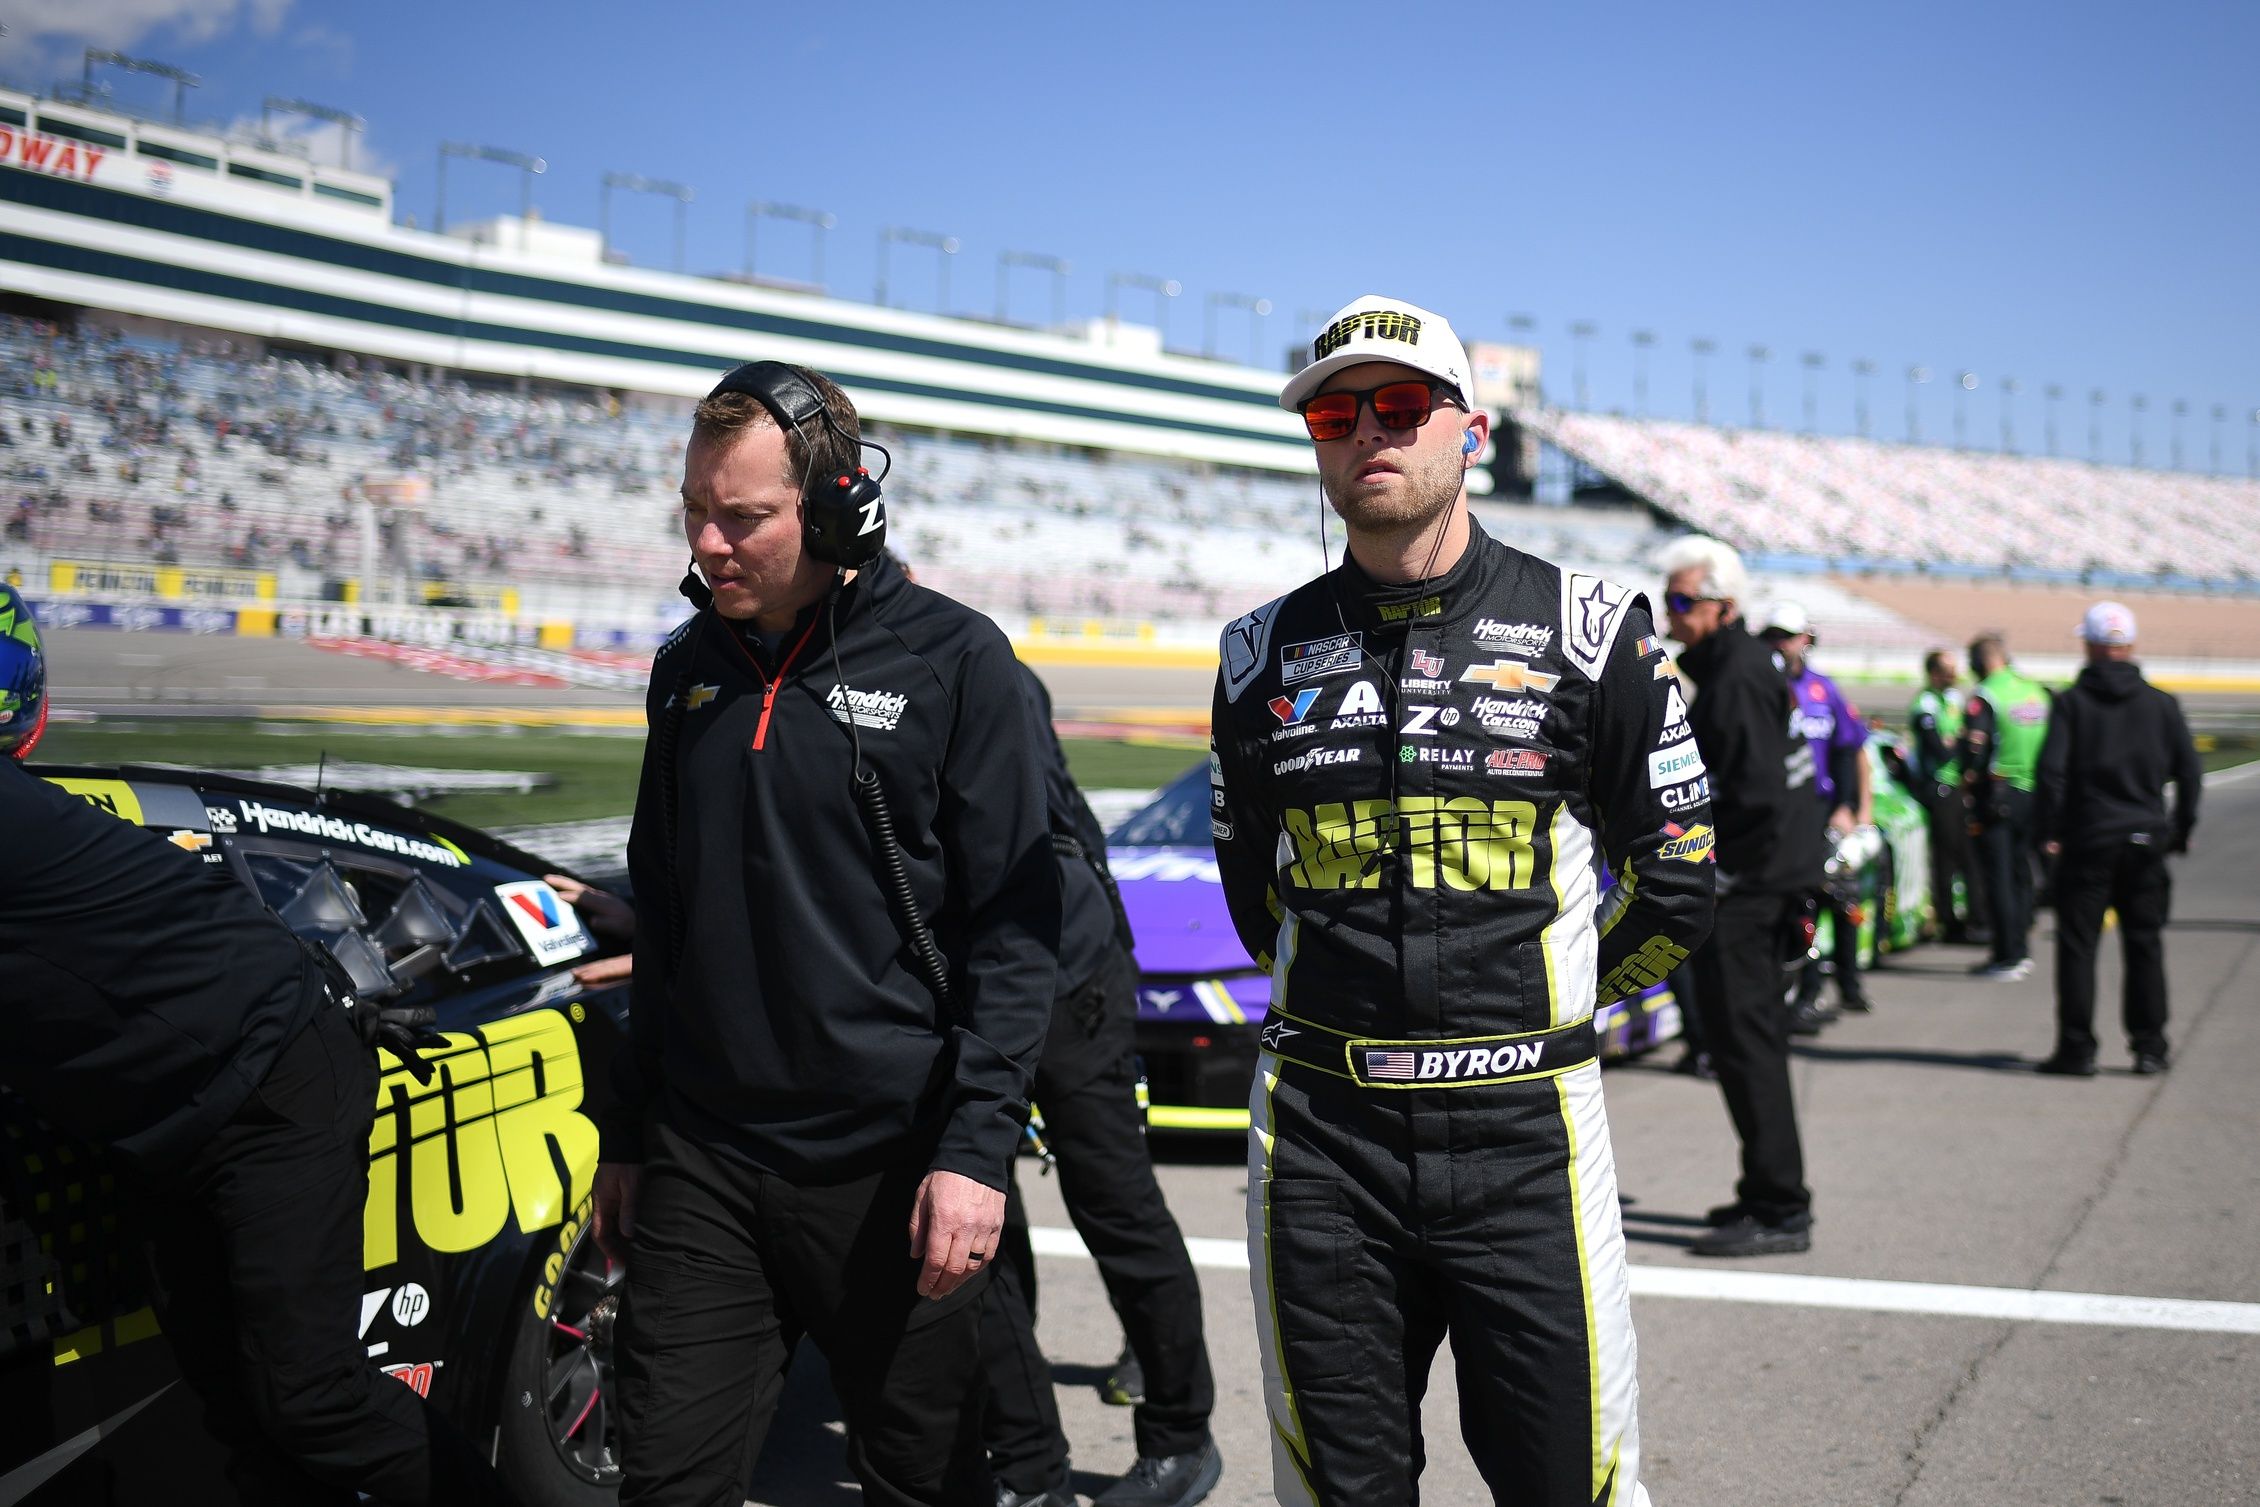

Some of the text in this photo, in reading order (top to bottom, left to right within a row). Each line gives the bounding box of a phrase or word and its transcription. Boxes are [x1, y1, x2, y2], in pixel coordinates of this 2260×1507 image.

[1314, 310, 1422, 362] RAPTOR
[1377, 597, 1441, 621] RAPTOR
[1473, 619, 1553, 643] Hendrick
[1485, 635, 1548, 647] MOTORSPORTS
[1308, 636, 1350, 657] NASCAR
[1293, 651, 1350, 676] CUP SERIES
[1401, 679, 1452, 690] LIBERTY
[1401, 688, 1451, 696] UNIVERSITY
[1441, 707, 1459, 726] hp
[1471, 696, 1549, 720] Hendrick
[1330, 714, 1389, 730] AXALTA
[1481, 713, 1540, 731] Cars.com
[1420, 747, 1475, 762] RELAY
[1486, 749, 1548, 770] ALL-PRO
[1285, 796, 1537, 892] RAPTOR
[1416, 1041, 1545, 1079] BYRON
[395, 1282, 427, 1328] hp
